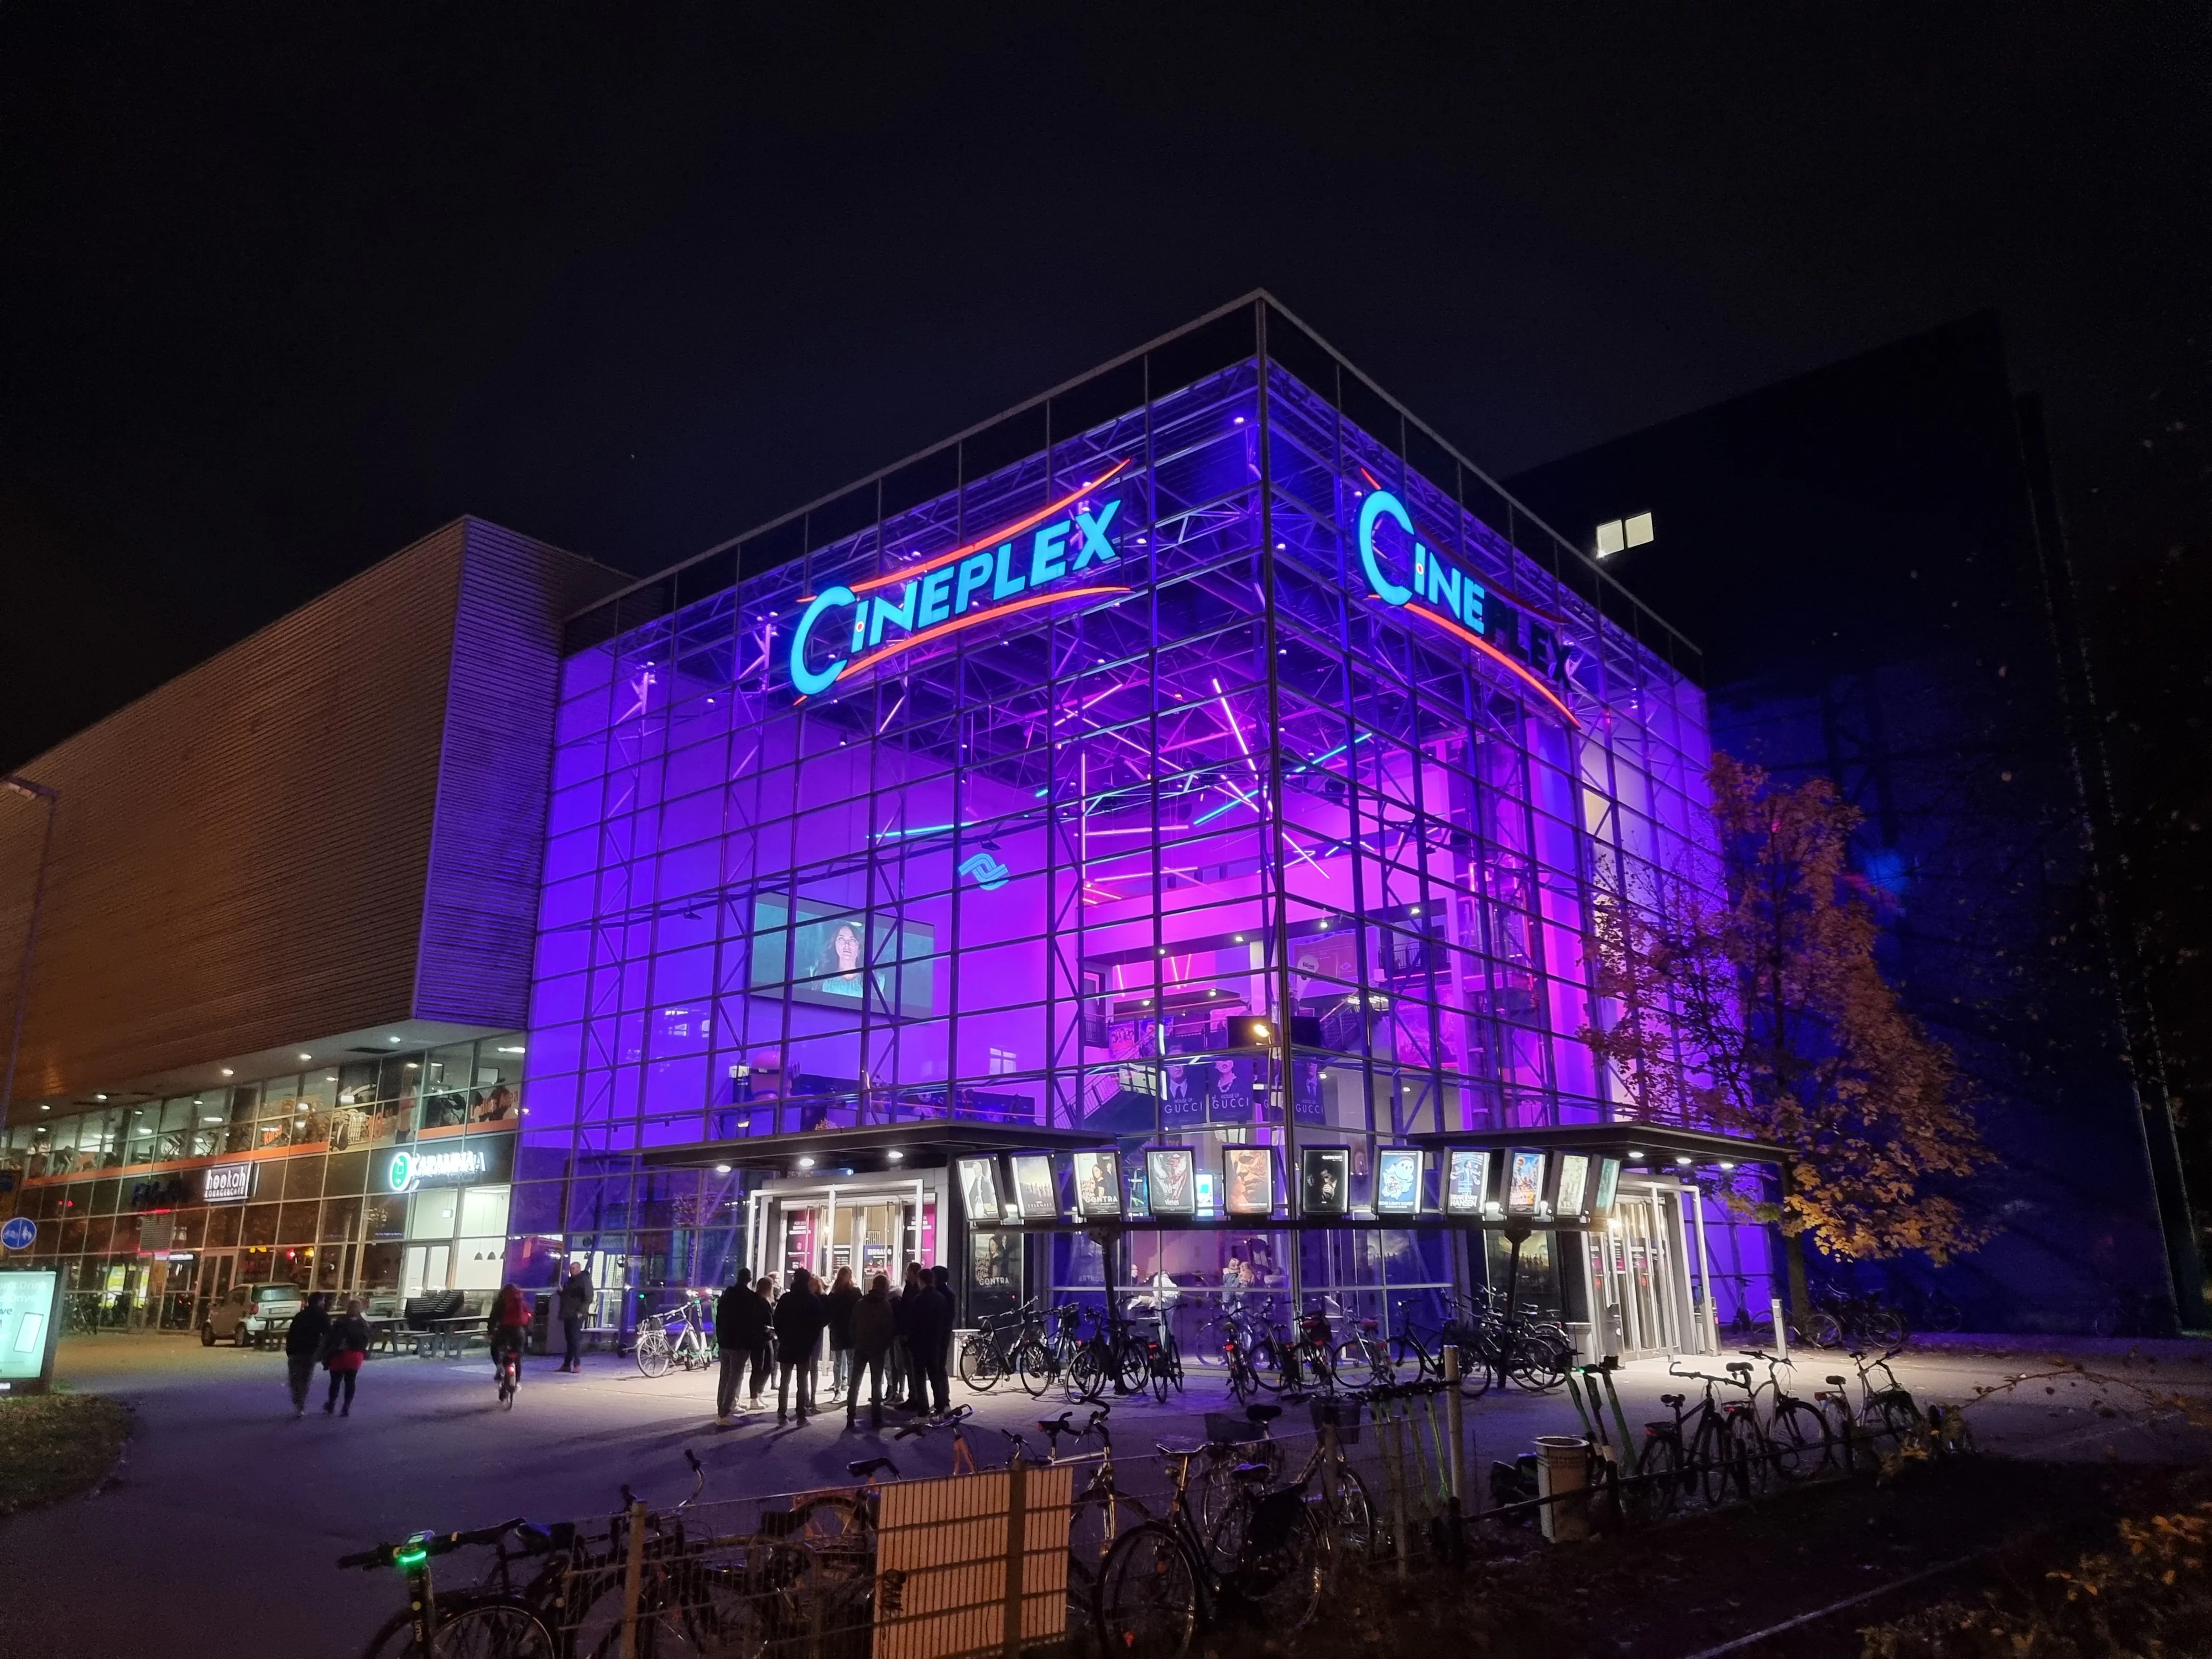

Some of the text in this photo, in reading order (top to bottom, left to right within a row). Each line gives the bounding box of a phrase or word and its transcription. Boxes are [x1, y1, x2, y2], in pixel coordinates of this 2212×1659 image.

[791, 499, 1121, 695] CINEPLEX
[1359, 491, 1572, 691] CINEPLEX
[1165, 1102, 1203, 1114] GUCCI
[1212, 1098, 1249, 1109] GUCCI
[1296, 1104, 1323, 1114] GUCCI
[205, 1166, 246, 1190] hookah
[979, 1276, 1010, 1286] CONTRA
